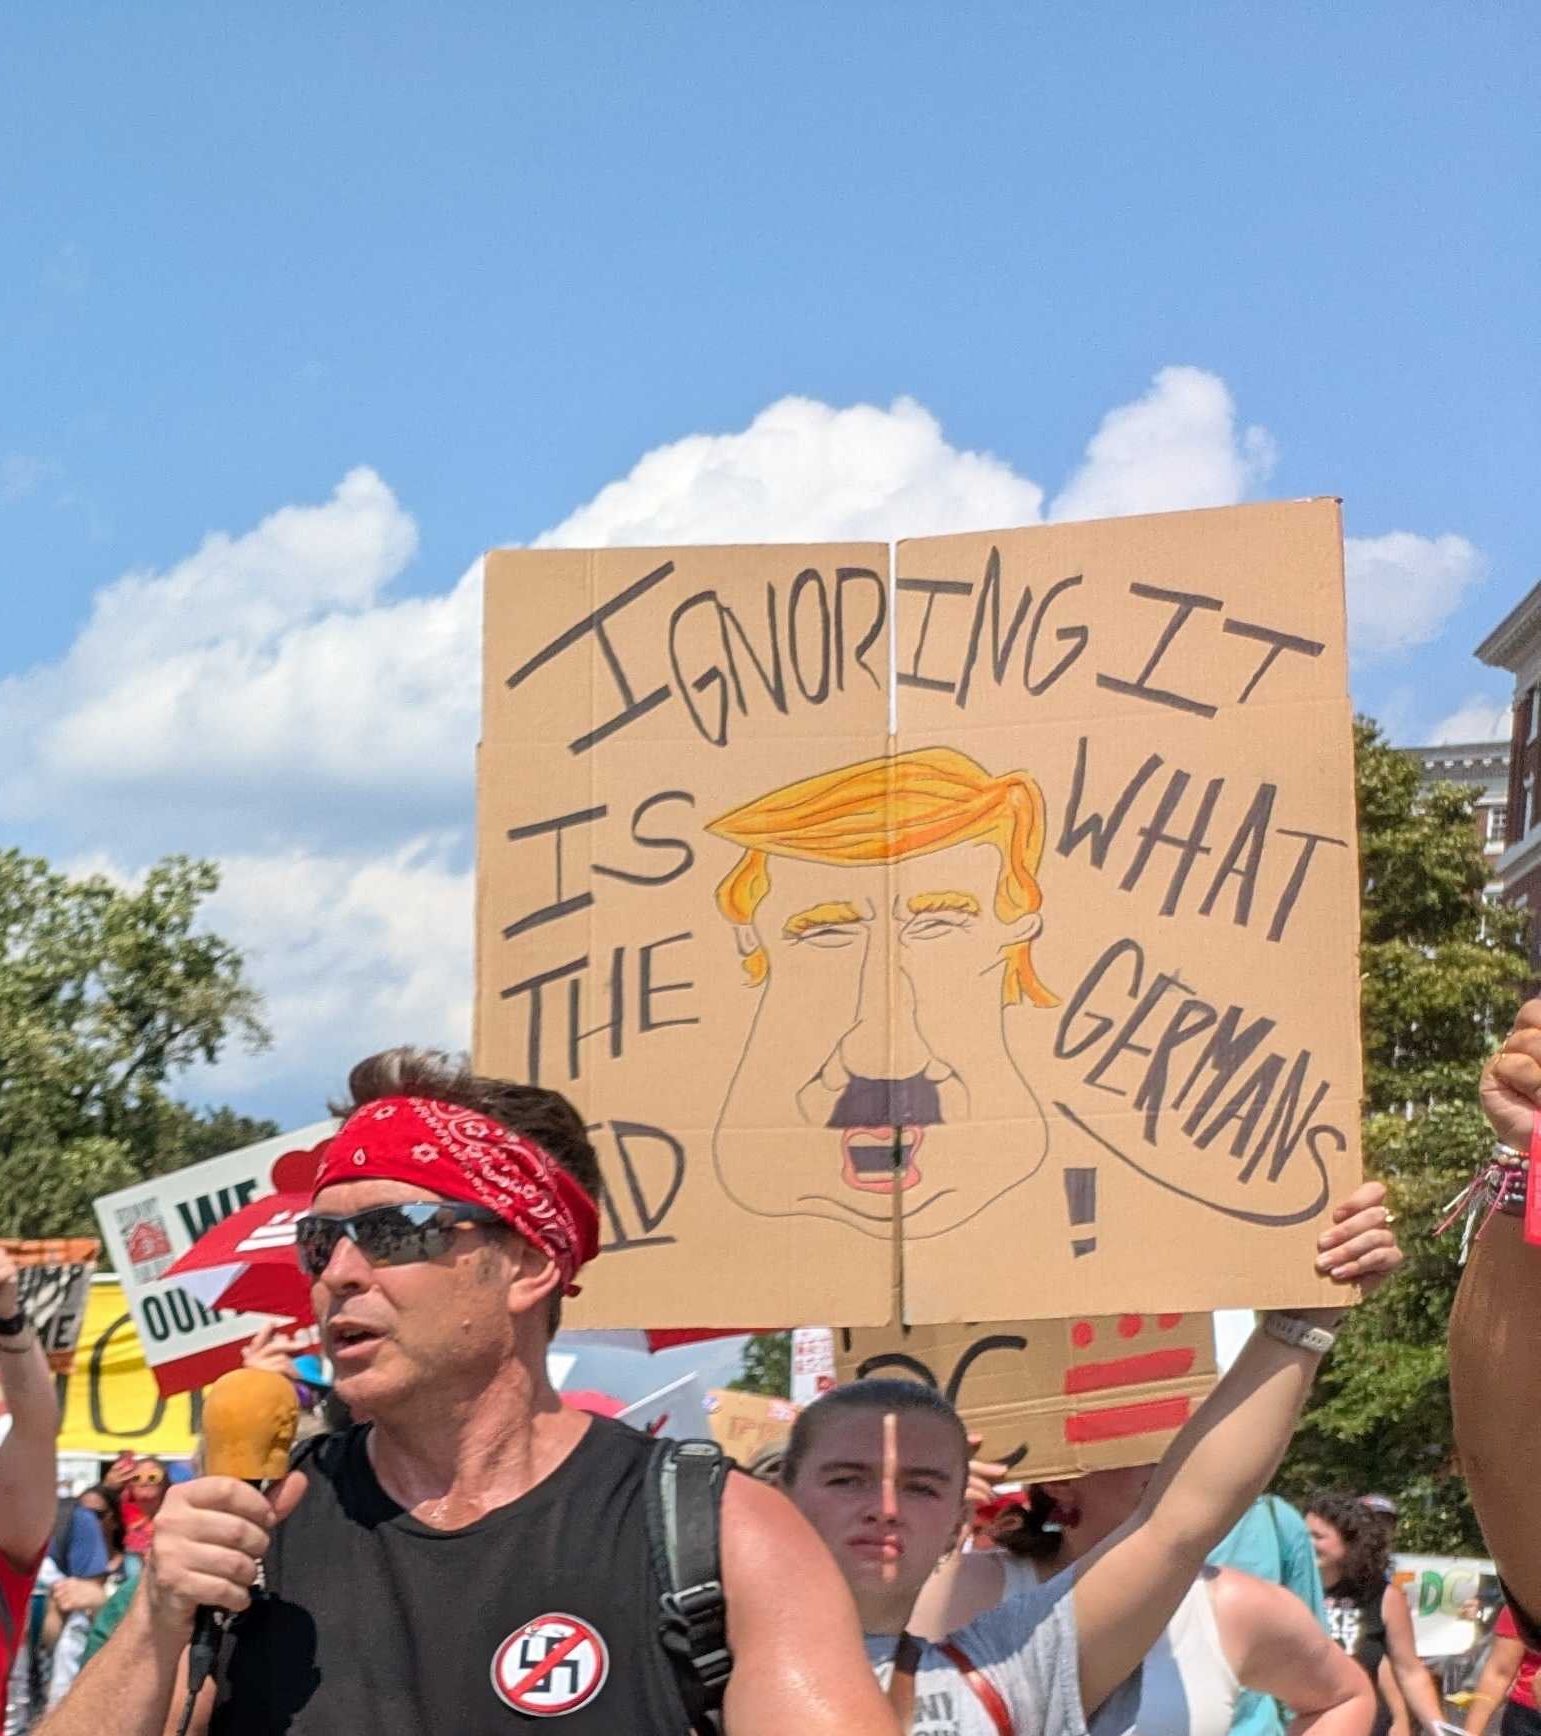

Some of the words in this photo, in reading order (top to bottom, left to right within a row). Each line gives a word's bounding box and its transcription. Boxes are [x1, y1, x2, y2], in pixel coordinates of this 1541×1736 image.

[507, 546, 1088, 755] IGNORING
[1097, 582, 1326, 717] IT
[502, 790, 695, 939] IS
[1056, 736, 1349, 943] WHAT
[500, 932, 700, 1086] THE
[1054, 938, 1347, 1229] GERMANS
[581, 1120, 685, 1253] ID
